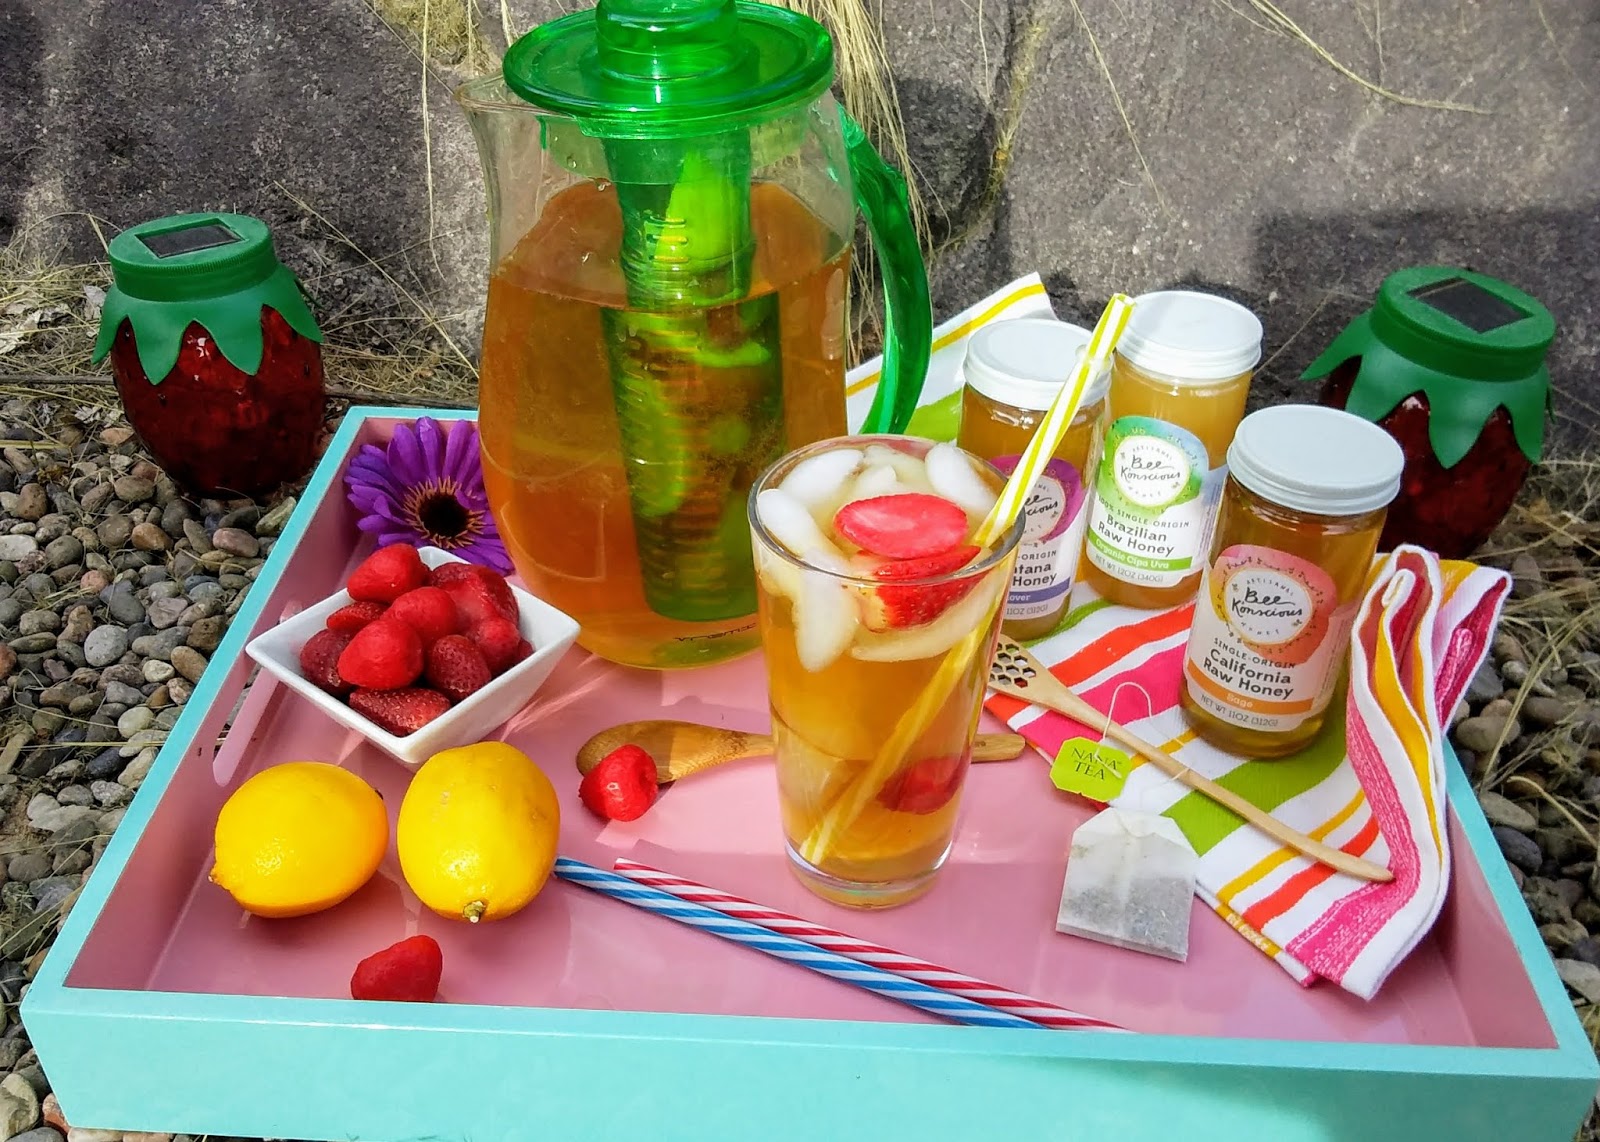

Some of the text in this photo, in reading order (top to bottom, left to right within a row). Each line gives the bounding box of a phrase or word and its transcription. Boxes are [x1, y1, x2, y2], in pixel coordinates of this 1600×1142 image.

[1131, 454, 1175, 471] Bee
[1024, 494, 1053, 506] ee
[1025, 500, 1058, 516] cious
[1106, 513, 1167, 542] Brazilian
[1098, 520, 1175, 558] Raw Honey
[1017, 550, 1057, 561] -ORIGIN
[1014, 563, 1052, 575] tana
[1012, 572, 1058, 587] Honey
[1008, 594, 1031, 602] over
[1244, 586, 1296, 606] Bee
[1210, 648, 1291, 684] California
[1203, 656, 1294, 701] Raw Honey
[1201, 694, 1214, 708] NET
[1215, 704, 1226, 715] WT
[1228, 710, 1249, 723] 11OZ
[1226, 692, 1254, 709] Sage
[1073, 759, 1105, 780] TEA
